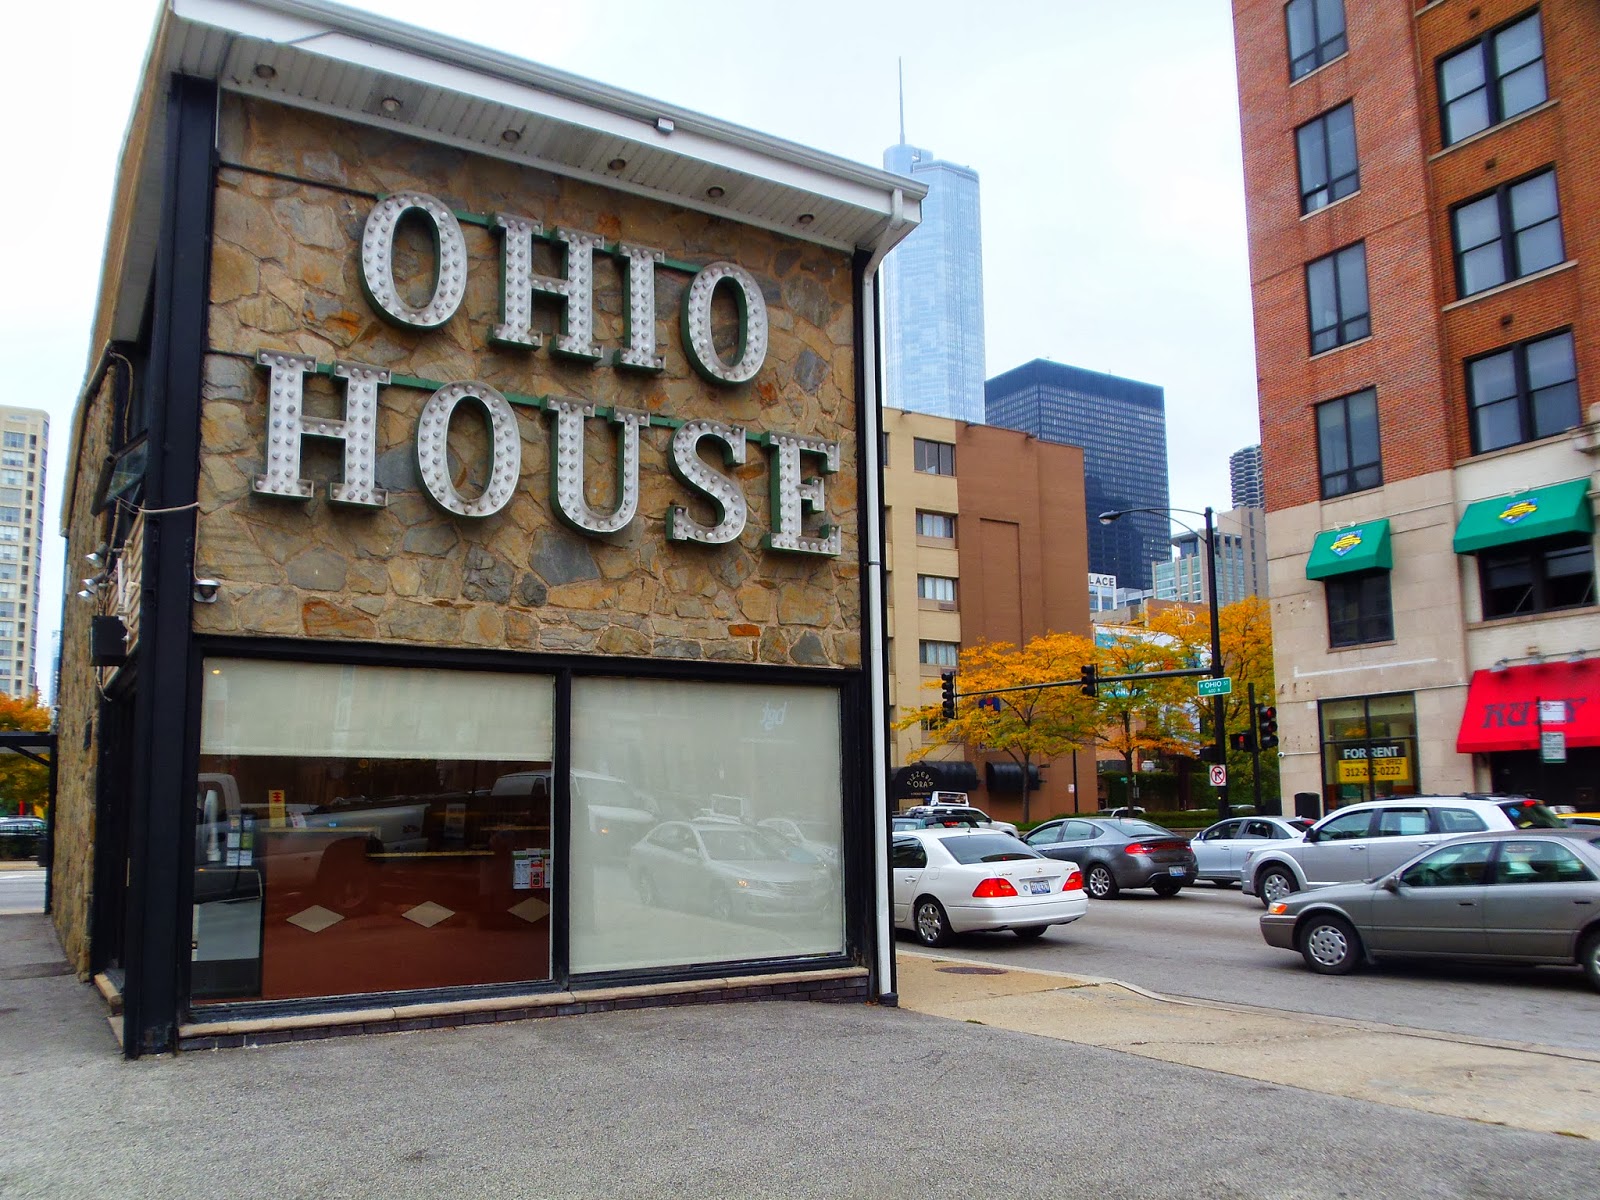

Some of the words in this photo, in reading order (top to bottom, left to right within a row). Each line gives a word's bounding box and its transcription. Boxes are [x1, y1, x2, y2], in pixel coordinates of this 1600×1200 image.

[358, 189, 769, 386] OHIO
[250, 348, 841, 557] HOUSE
[1204, 681, 1222, 689] OHIO
[1343, 748, 1368, 759] FOR
[1371, 746, 1399, 758] RENT
[1345, 766, 1401, 777] 312-22-0222
[906, 771, 934, 787] PIZZERIA
